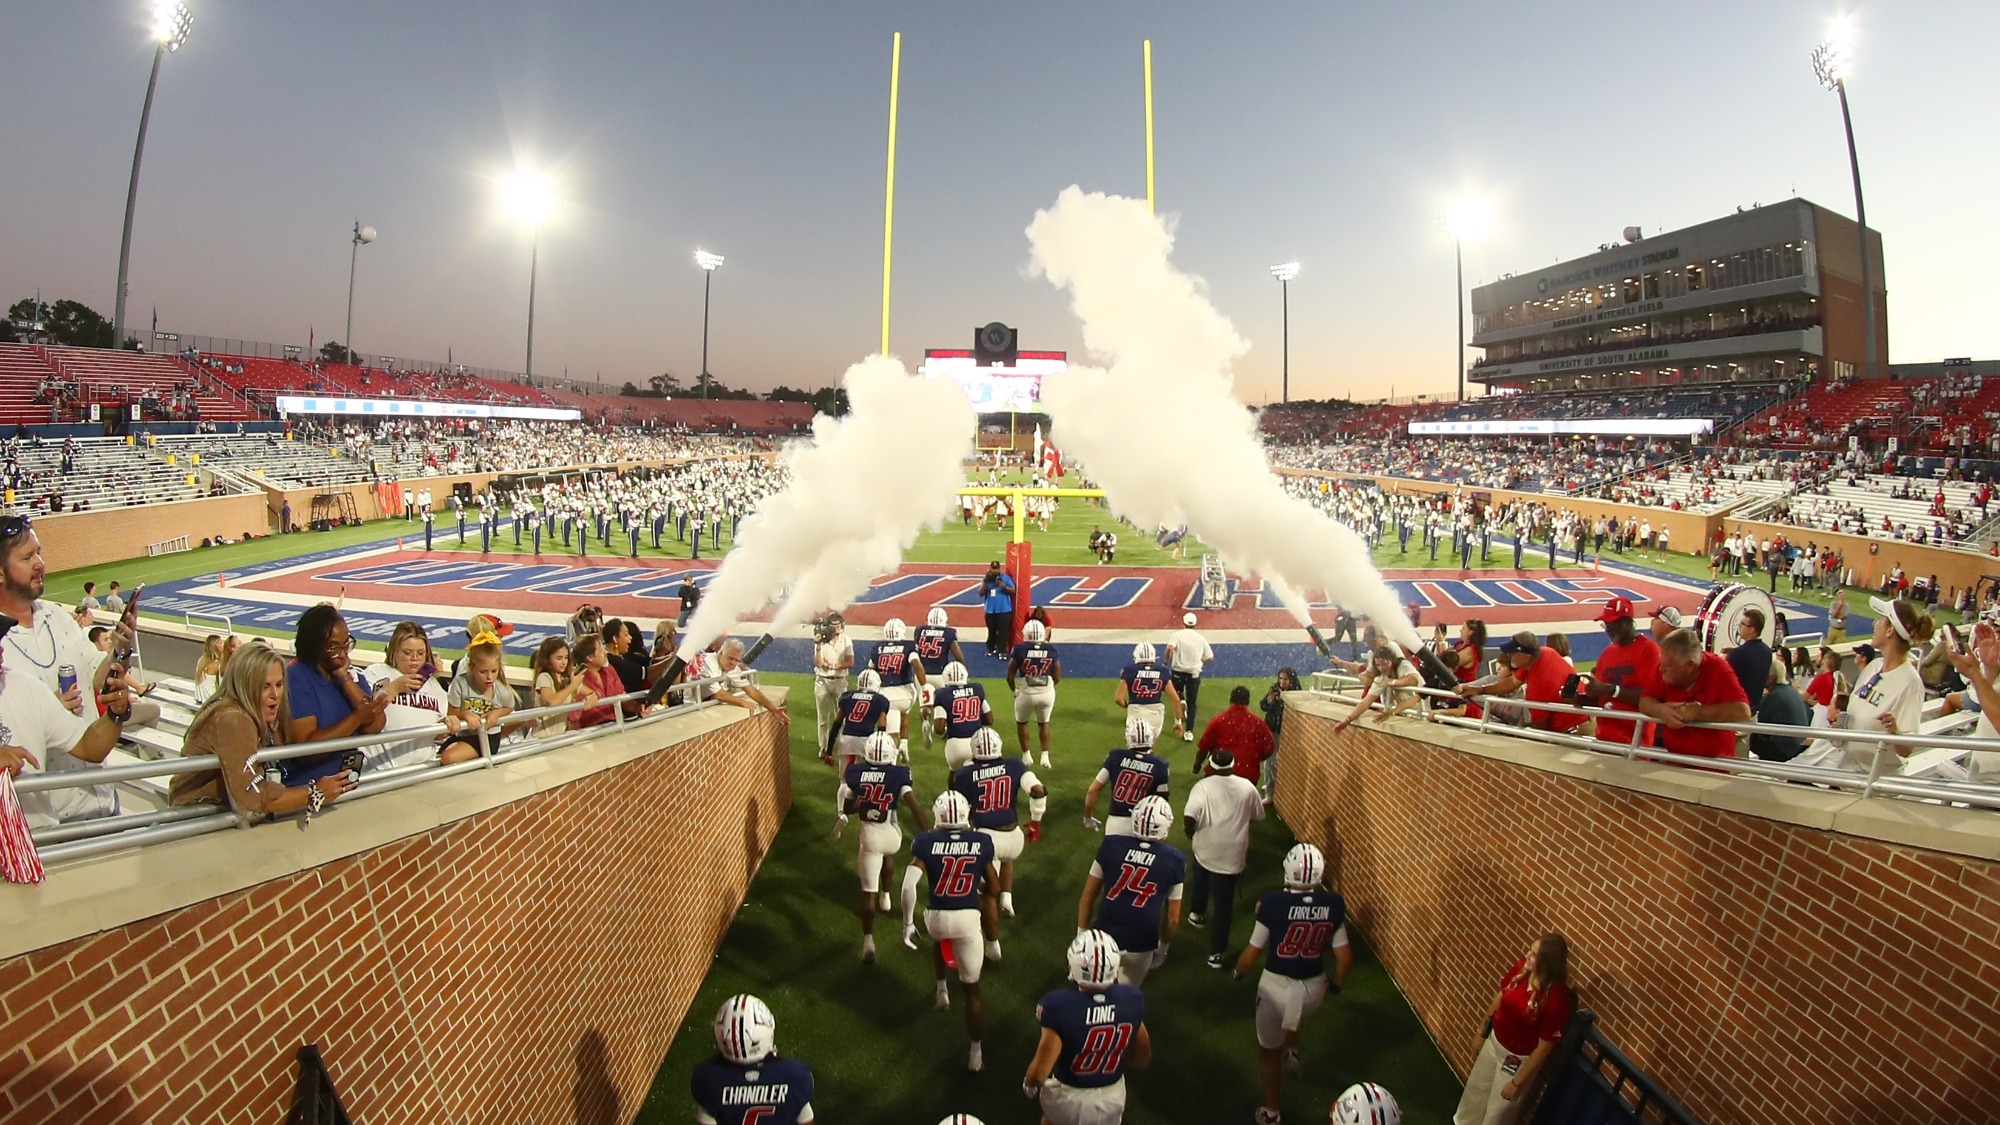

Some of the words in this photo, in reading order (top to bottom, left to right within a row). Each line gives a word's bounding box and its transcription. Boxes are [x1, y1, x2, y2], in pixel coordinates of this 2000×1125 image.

[1641, 247, 1679, 266] STADIUM
[1552, 315, 1586, 328] ABRAHAM
[1597, 304, 1635, 320] MITCHELL
[1638, 301, 1664, 312] FIELD
[1539, 357, 1581, 371] UNIVERSITY
[1584, 357, 1594, 366] OF
[1597, 354, 1625, 365] SOUTH
[1628, 349, 1669, 360] ALABAMA
[919, 636, 945, 659] 45
[878, 653, 905, 676] 99
[1022, 658, 1053, 677] 47
[952, 687, 974, 699] SMILEY
[1132, 678, 1163, 698] 42
[409, 692, 440, 713] ALABAMA
[848, 700, 871, 723] 8
[952, 695, 981, 724] 90
[860, 771, 886, 783] DARBY
[1113, 769, 1154, 805] 80
[856, 783, 894, 811] 24
[976, 775, 1012, 814] 30
[1124, 848, 1156, 867] LYNCH
[934, 856, 977, 897] 16
[1106, 862, 1158, 908] 14
[1287, 905, 1330, 920] CARLSON
[1276, 921, 1334, 958] 88
[1085, 1004, 1116, 1026] LONG
[1070, 1022, 1133, 1076] 81
[721, 1083, 789, 1106] CHANDLER
